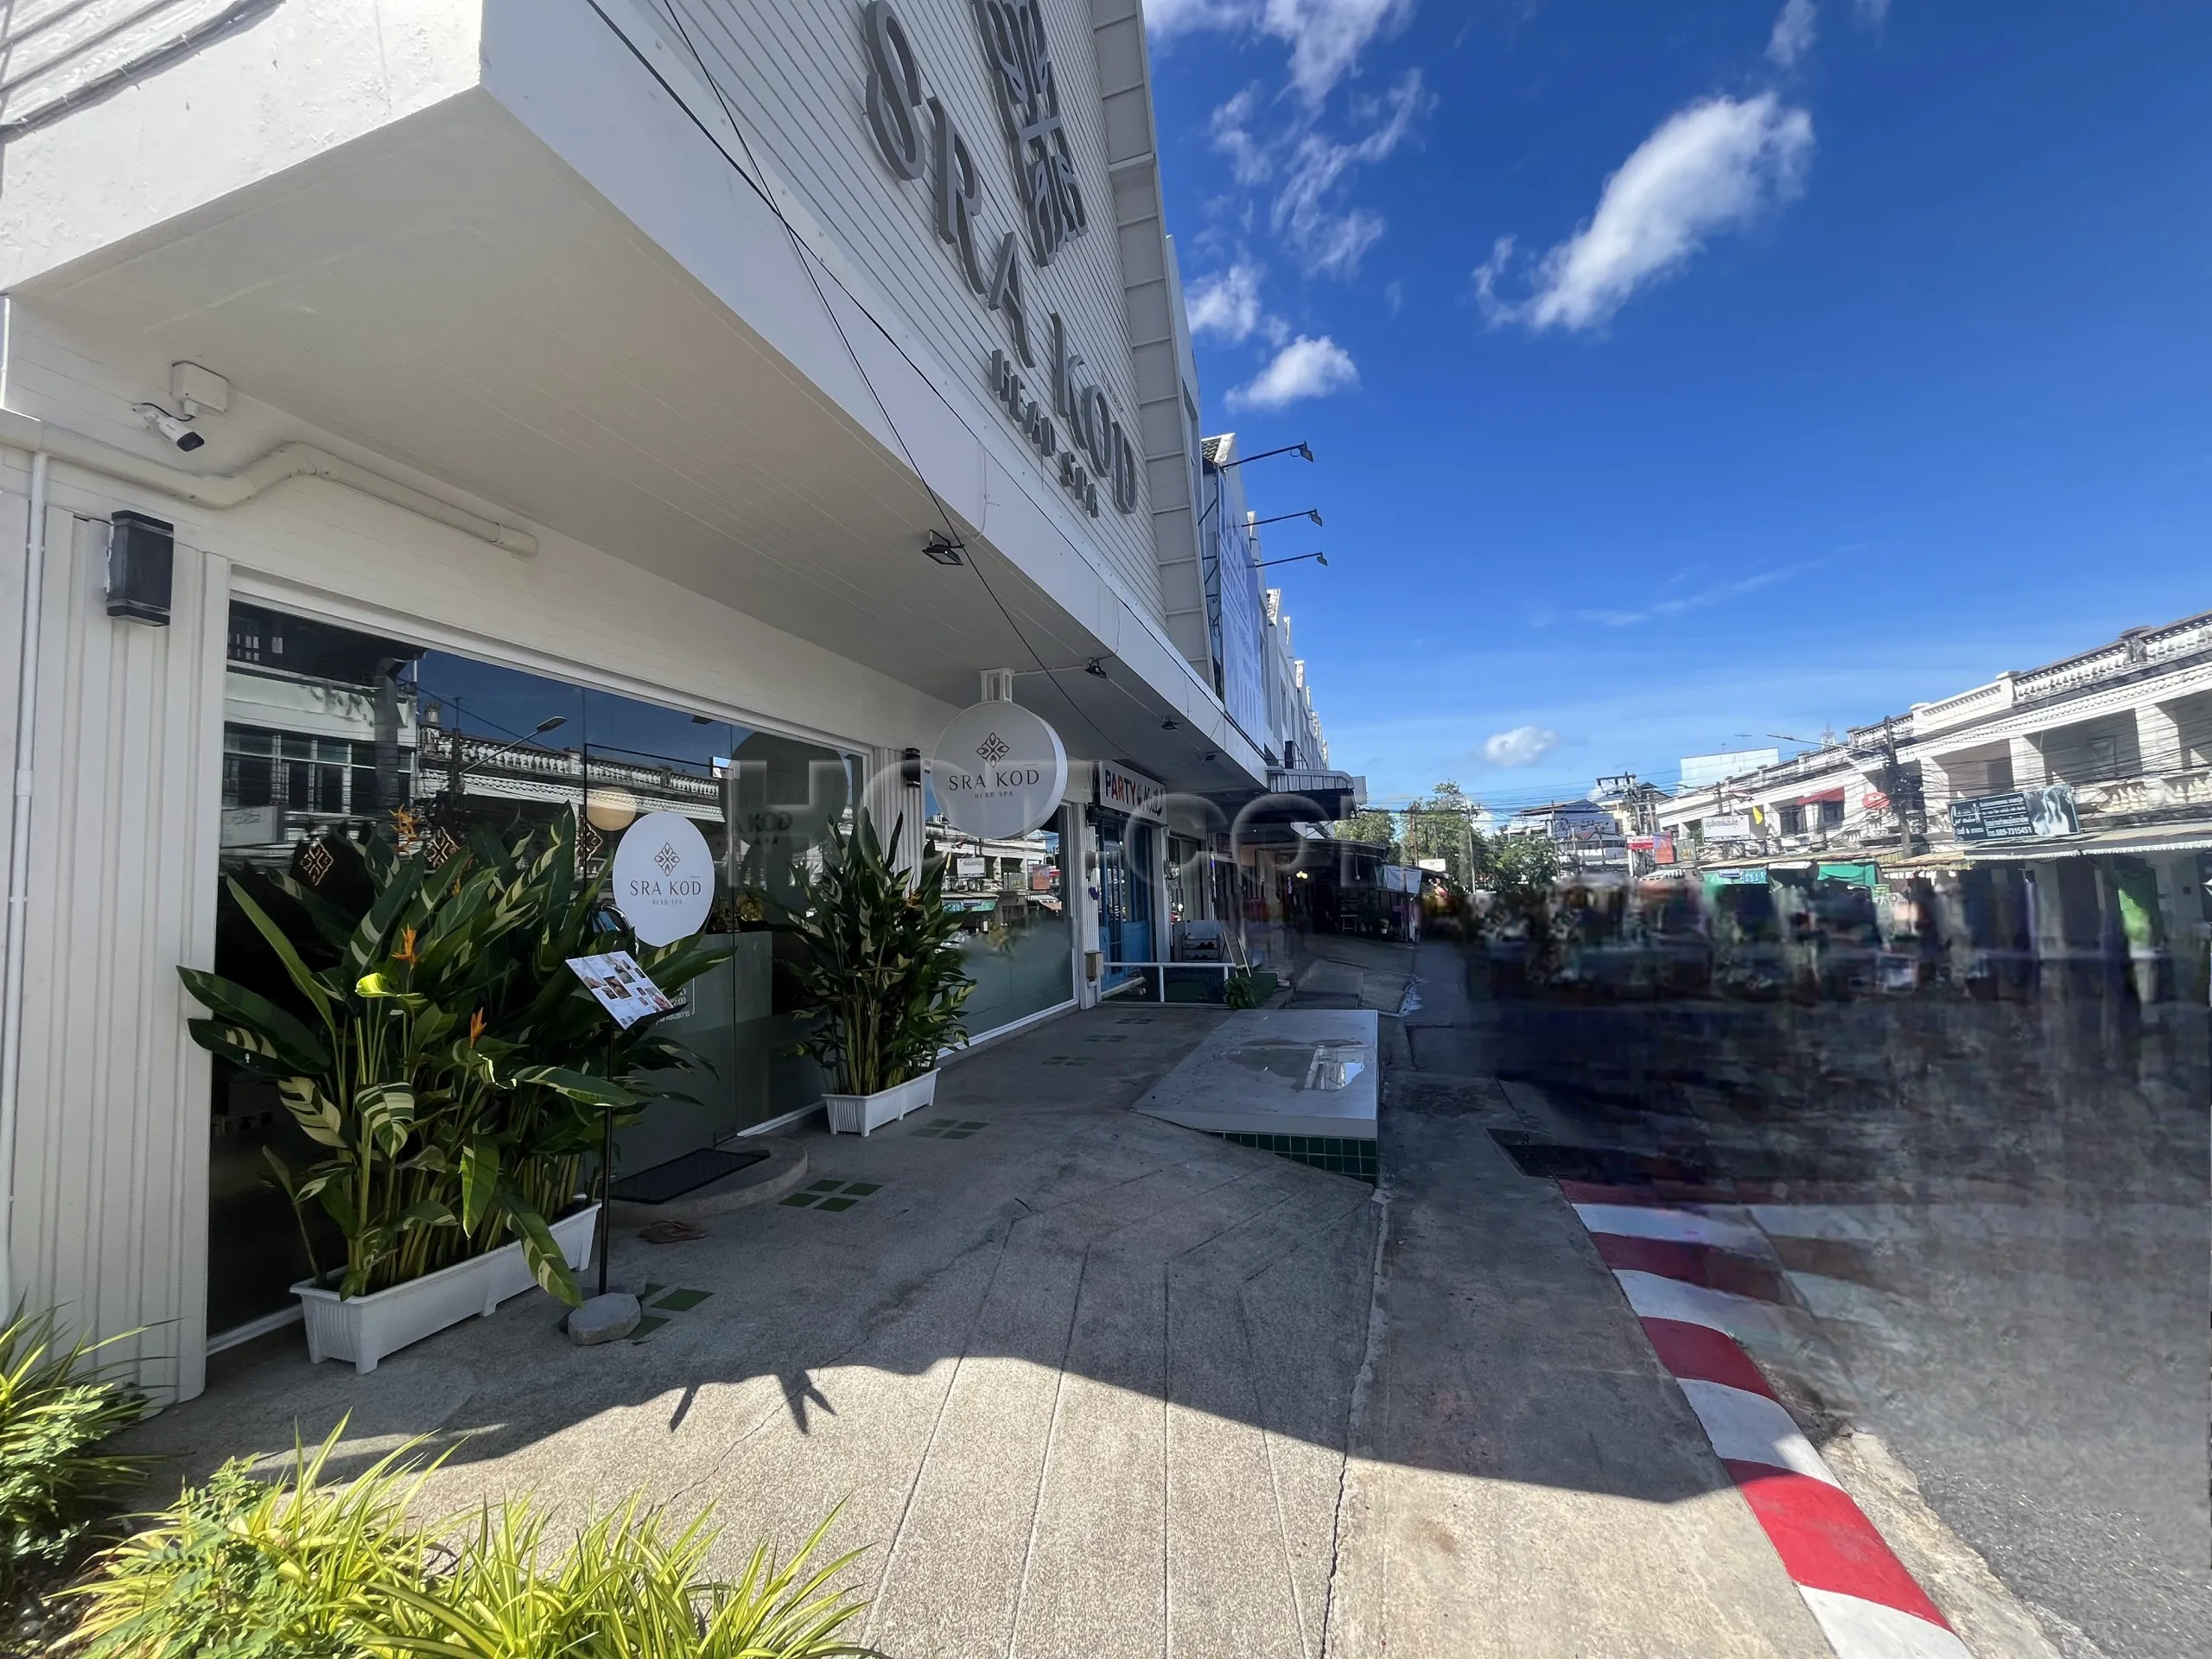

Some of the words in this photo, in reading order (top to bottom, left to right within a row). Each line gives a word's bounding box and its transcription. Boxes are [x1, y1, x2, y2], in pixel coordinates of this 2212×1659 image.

[864, 1, 1036, 369] SRA
[1049, 312, 1137, 515] KOD
[992, 348, 1057, 458] HEAD
[1059, 450, 1100, 518] SPA
[949, 773, 986, 791] SRA
[995, 769, 1039, 788] KOD
[1105, 768, 1136, 807] PARTY
[630, 880, 662, 896] SRA
[670, 880, 702, 896] KOD
